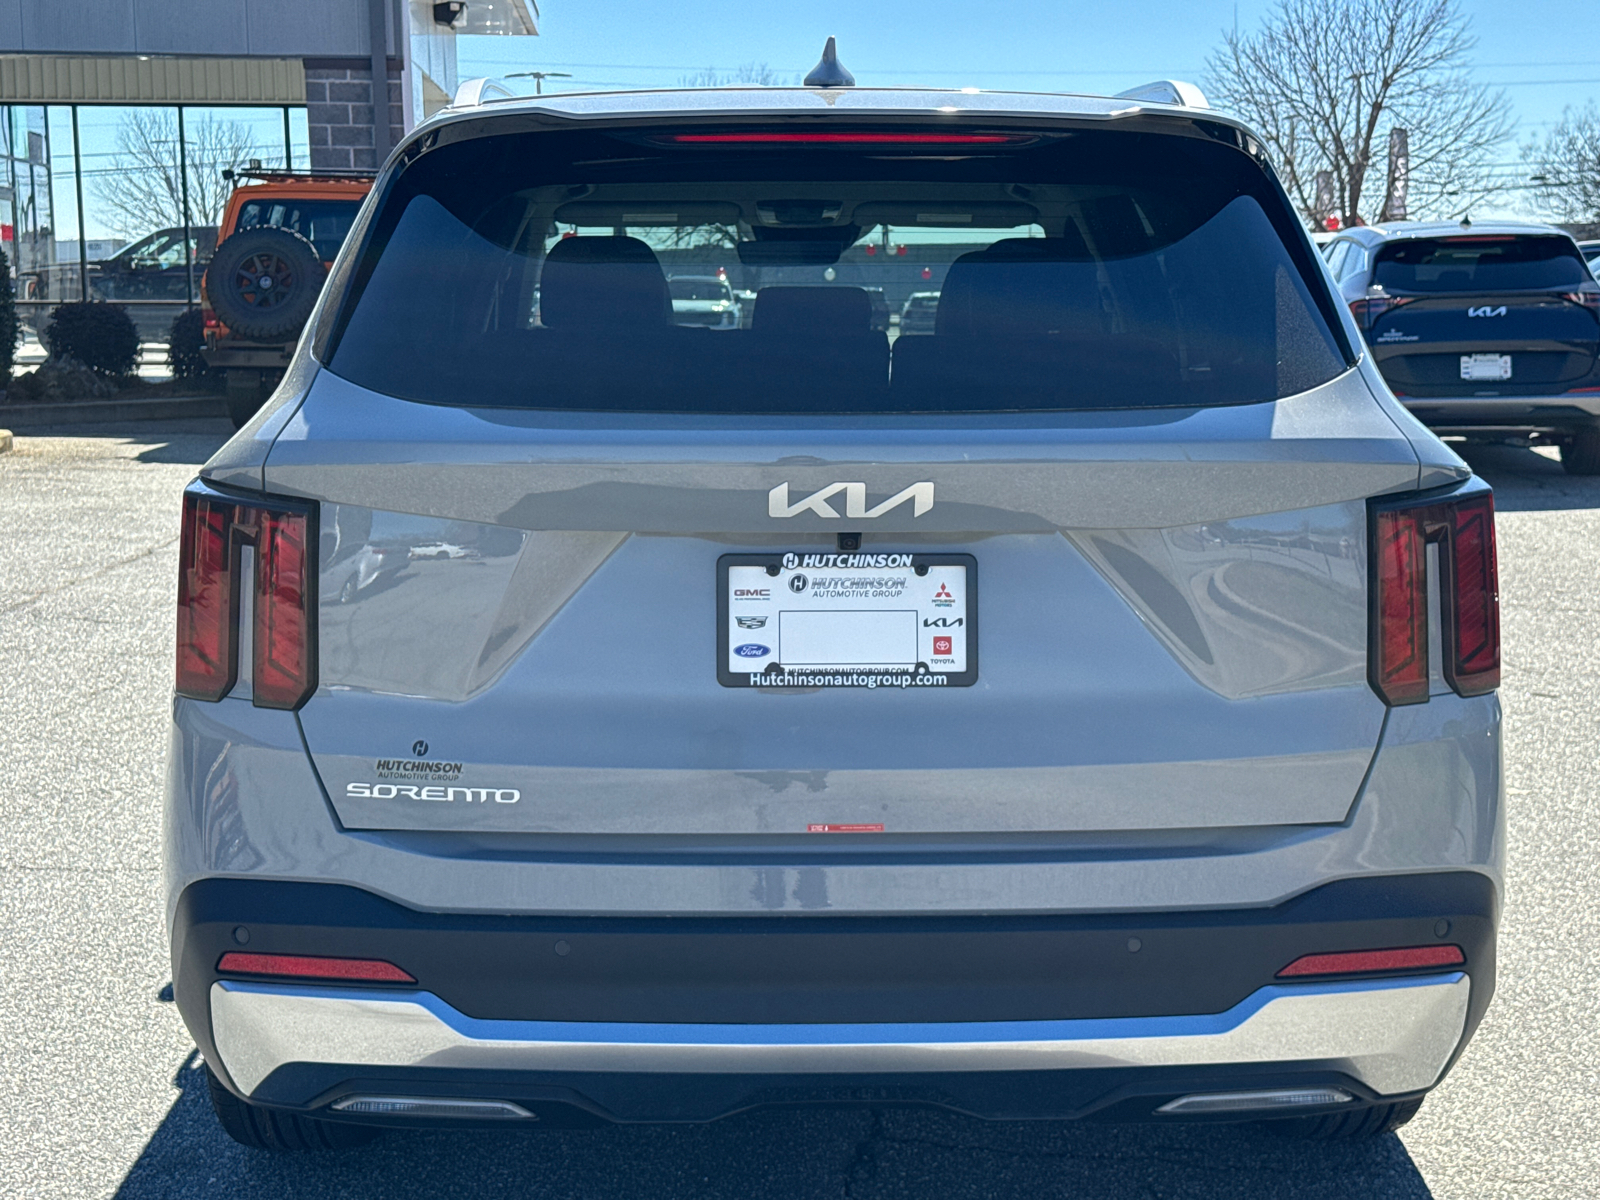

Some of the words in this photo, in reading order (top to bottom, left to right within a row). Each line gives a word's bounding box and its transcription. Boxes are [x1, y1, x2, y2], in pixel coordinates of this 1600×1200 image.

[1468, 306, 1507, 318] KIA
[768, 481, 935, 518] KIA
[802, 554, 913, 568] HUTCHINSON
[811, 577, 906, 590] HUTCHINSON
[812, 590, 869, 598] AUTOMOTIVE
[872, 590, 902, 598] GROUP
[923, 617, 964, 627] KIA
[741, 645, 764, 656] Ford
[750, 672, 948, 688] Hutchinsonautogroup.com
[376, 759, 462, 773] HUTCHINSON
[378, 771, 429, 780] AUTOMOTIVE
[431, 773, 459, 781] GROUP
[346, 782, 521, 803] SORENTO
